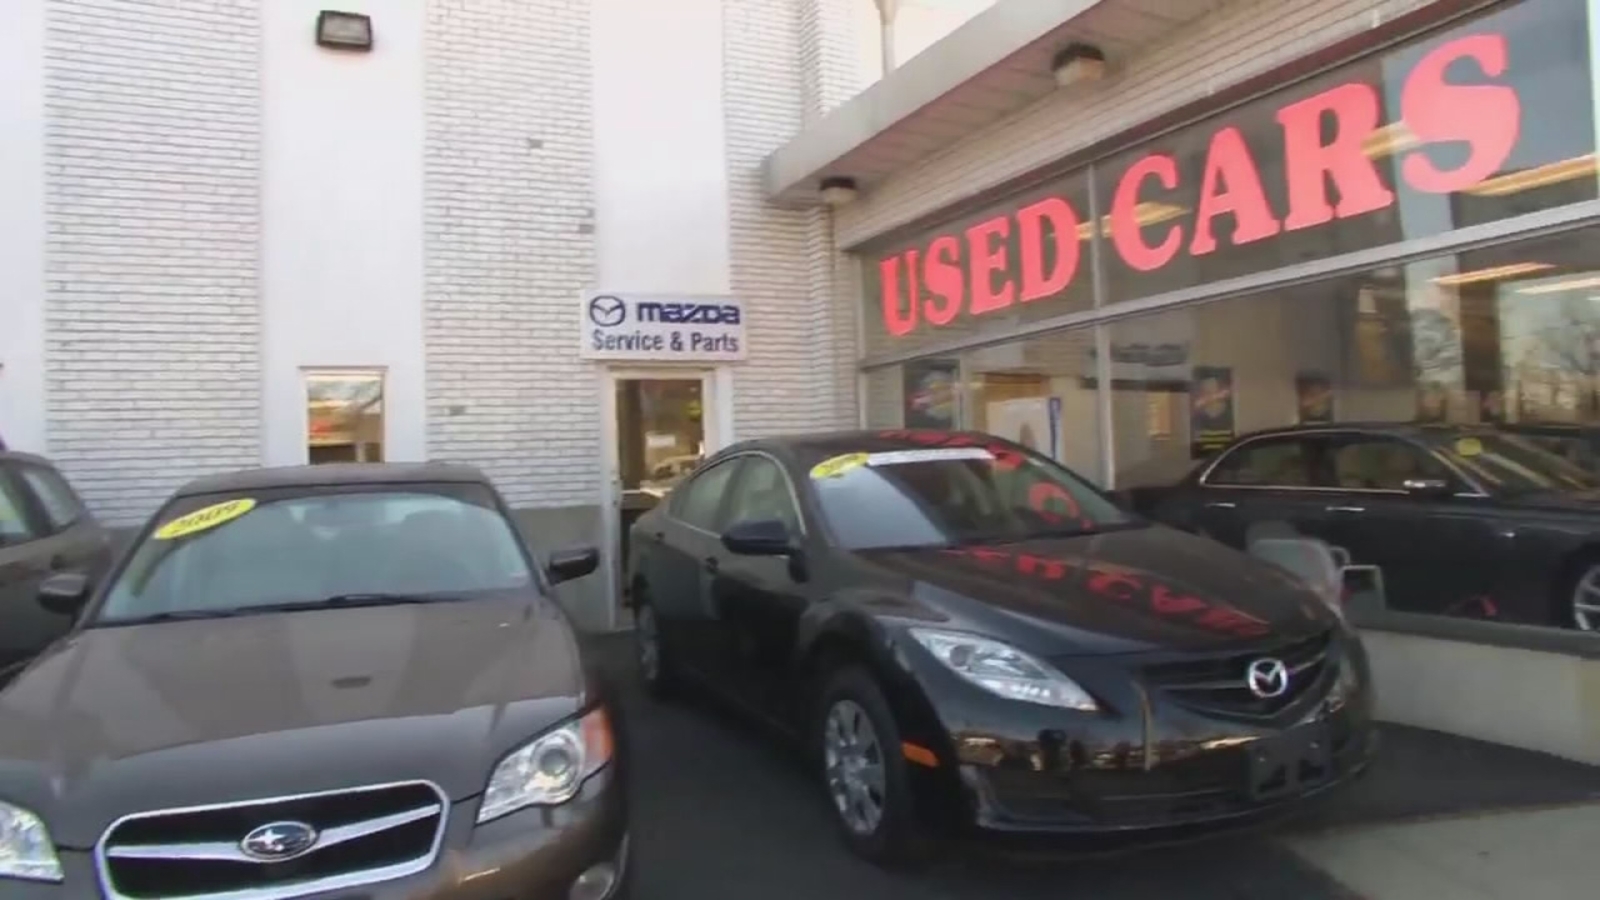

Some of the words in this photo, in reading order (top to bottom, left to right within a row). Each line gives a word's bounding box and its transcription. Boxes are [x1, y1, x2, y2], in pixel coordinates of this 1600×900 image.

[879, 197, 1080, 337] USED
[1110, 34, 1521, 272] CARS
[592, 329, 665, 352] Service
[670, 331, 684, 352] &
[691, 332, 740, 353] Parts
